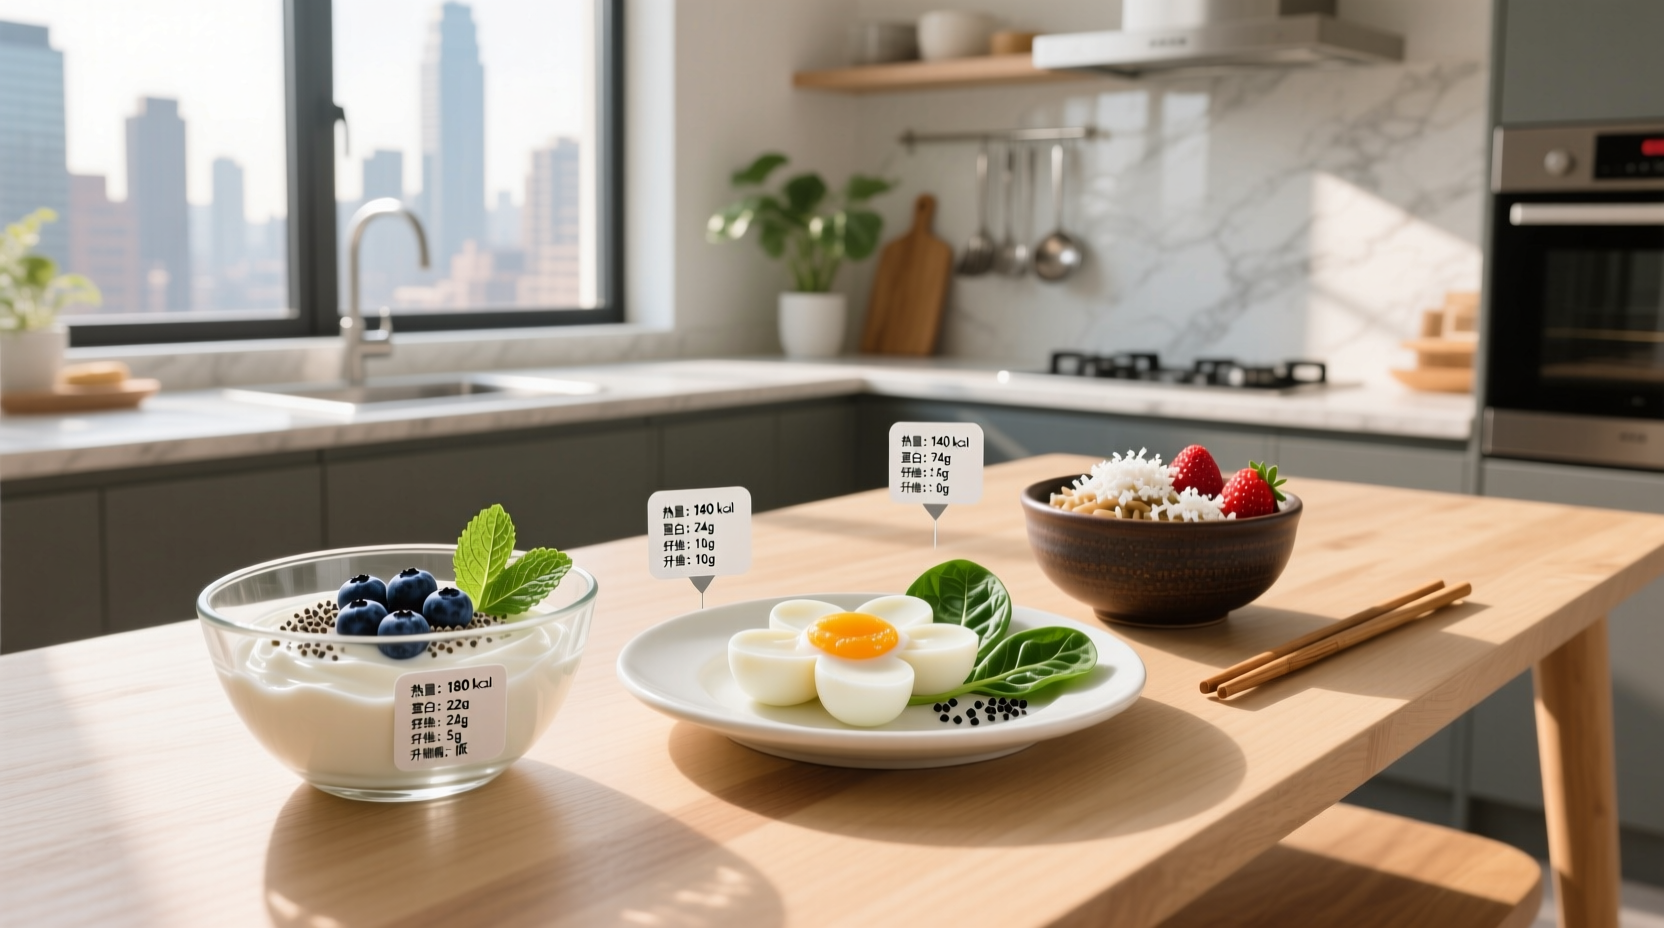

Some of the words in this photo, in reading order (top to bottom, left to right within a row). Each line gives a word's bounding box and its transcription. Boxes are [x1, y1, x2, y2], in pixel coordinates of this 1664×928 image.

[931, 435, 950, 448] 140
[693, 503, 714, 516] 140
[695, 537, 715, 551] 10g
[695, 553, 715, 567] 10g
[447, 679, 470, 693] 180
